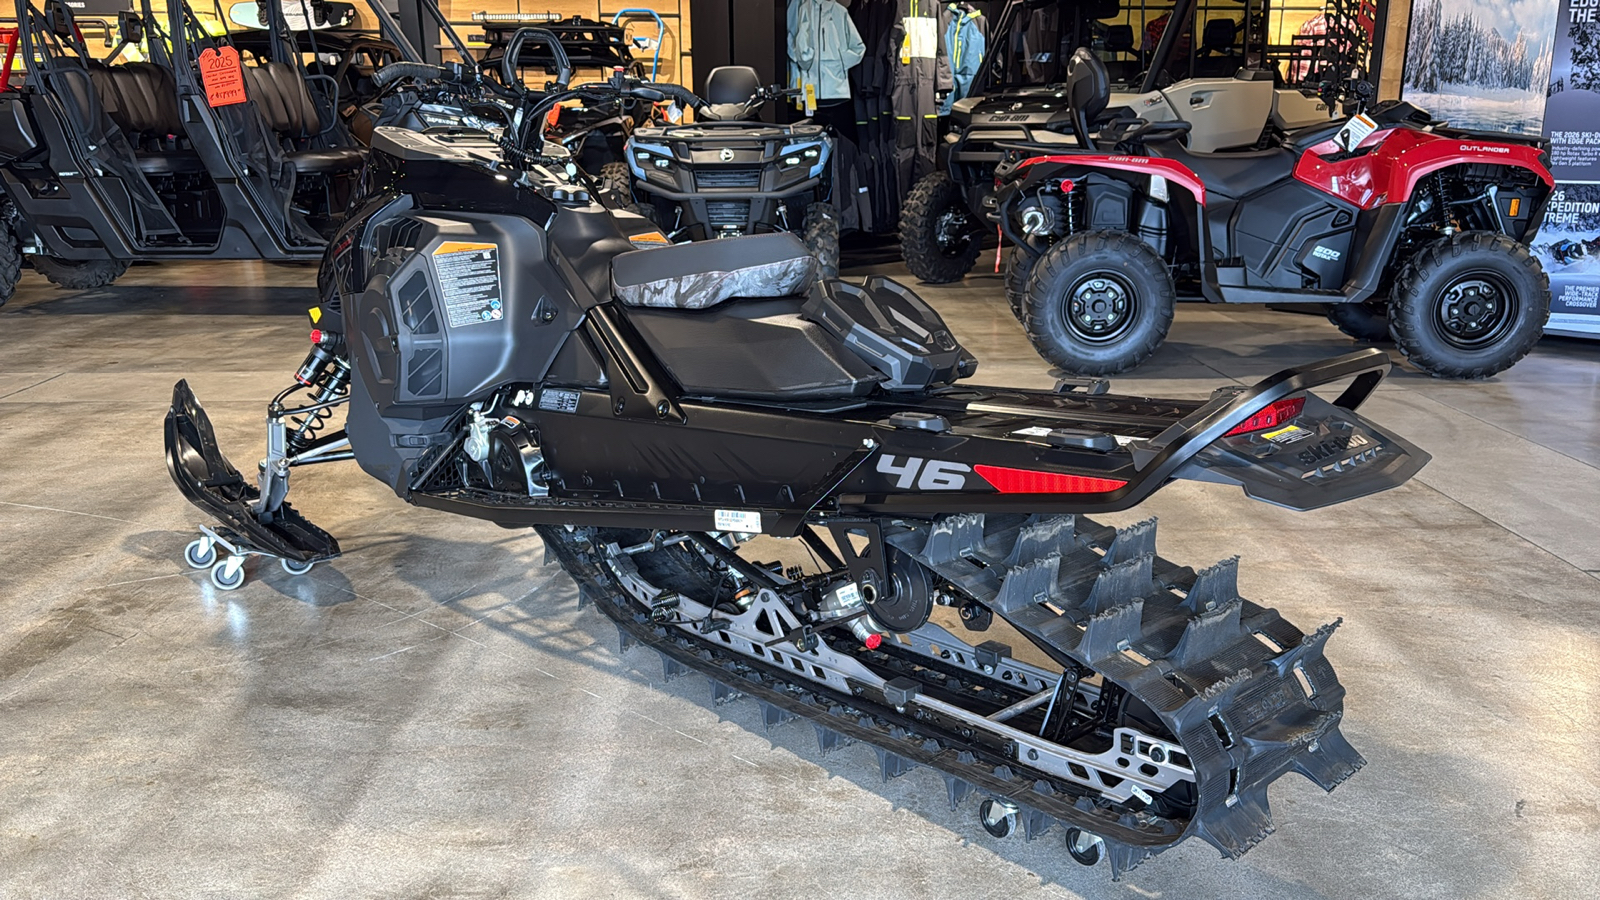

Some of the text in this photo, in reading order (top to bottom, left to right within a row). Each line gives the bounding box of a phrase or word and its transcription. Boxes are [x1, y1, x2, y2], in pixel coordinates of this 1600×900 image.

[1569, 8, 1597, 23] THE
[208, 55, 233, 70] 2025
[1460, 145, 1510, 154] OUTLANDER
[1551, 190, 1565, 200] 26
[876, 454, 971, 491] 46
